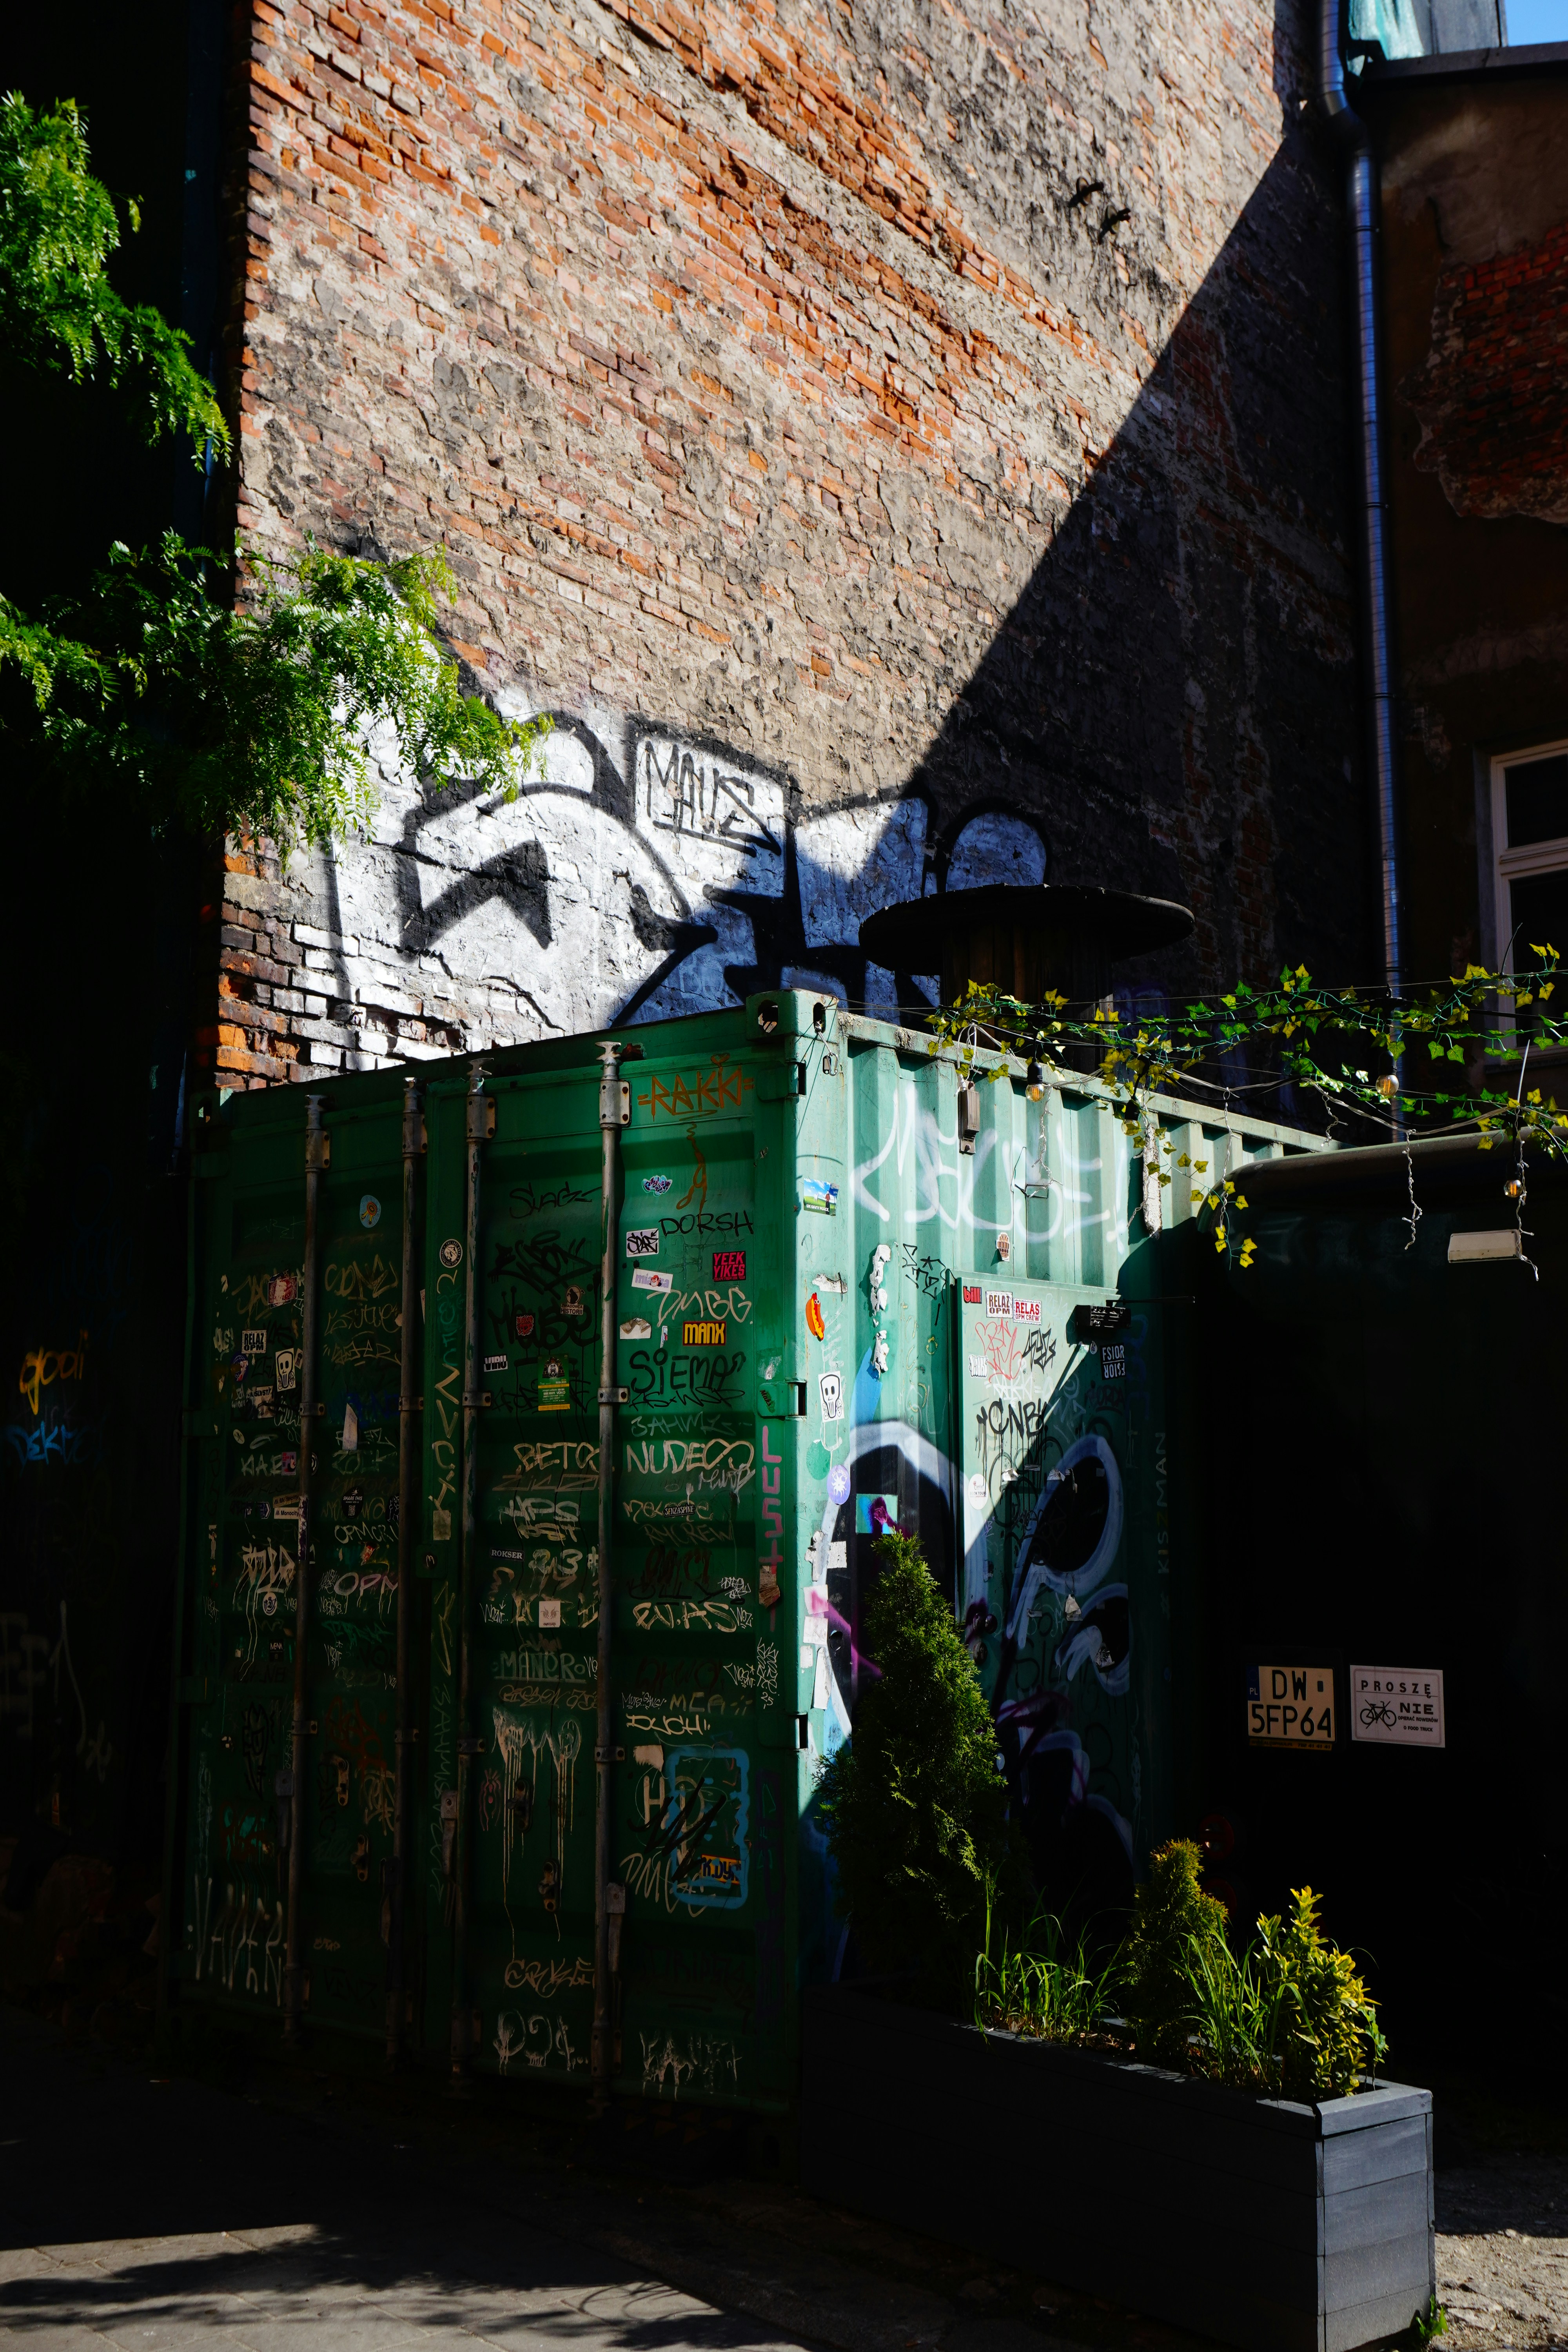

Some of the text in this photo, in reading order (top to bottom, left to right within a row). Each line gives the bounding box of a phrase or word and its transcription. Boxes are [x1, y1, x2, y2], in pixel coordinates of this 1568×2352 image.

[659, 1210, 753, 1237] DORSH
[713, 1252, 745, 1265] YEEK
[713, 1264, 745, 1278] YIKES
[964, 1286, 981, 1303] bill
[989, 1295, 1010, 1308] RELAZ
[1016, 1302, 1040, 1315] RELAS
[244, 1333, 264, 1345] RELAZ
[1102, 1345, 1125, 1361] FSIOR
[665, 1506, 694, 1516] SENZASPINE
[491, 1549, 523, 1559] ROKSER
[1249, 1687, 1258, 1695] PL
[1272, 1670, 1306, 1700] DW
[1361, 1680, 1431, 1699] PROSZĘ
[1400, 1702, 1434, 1715] NIE
[1252, 1704, 1331, 1738] 5FP64
